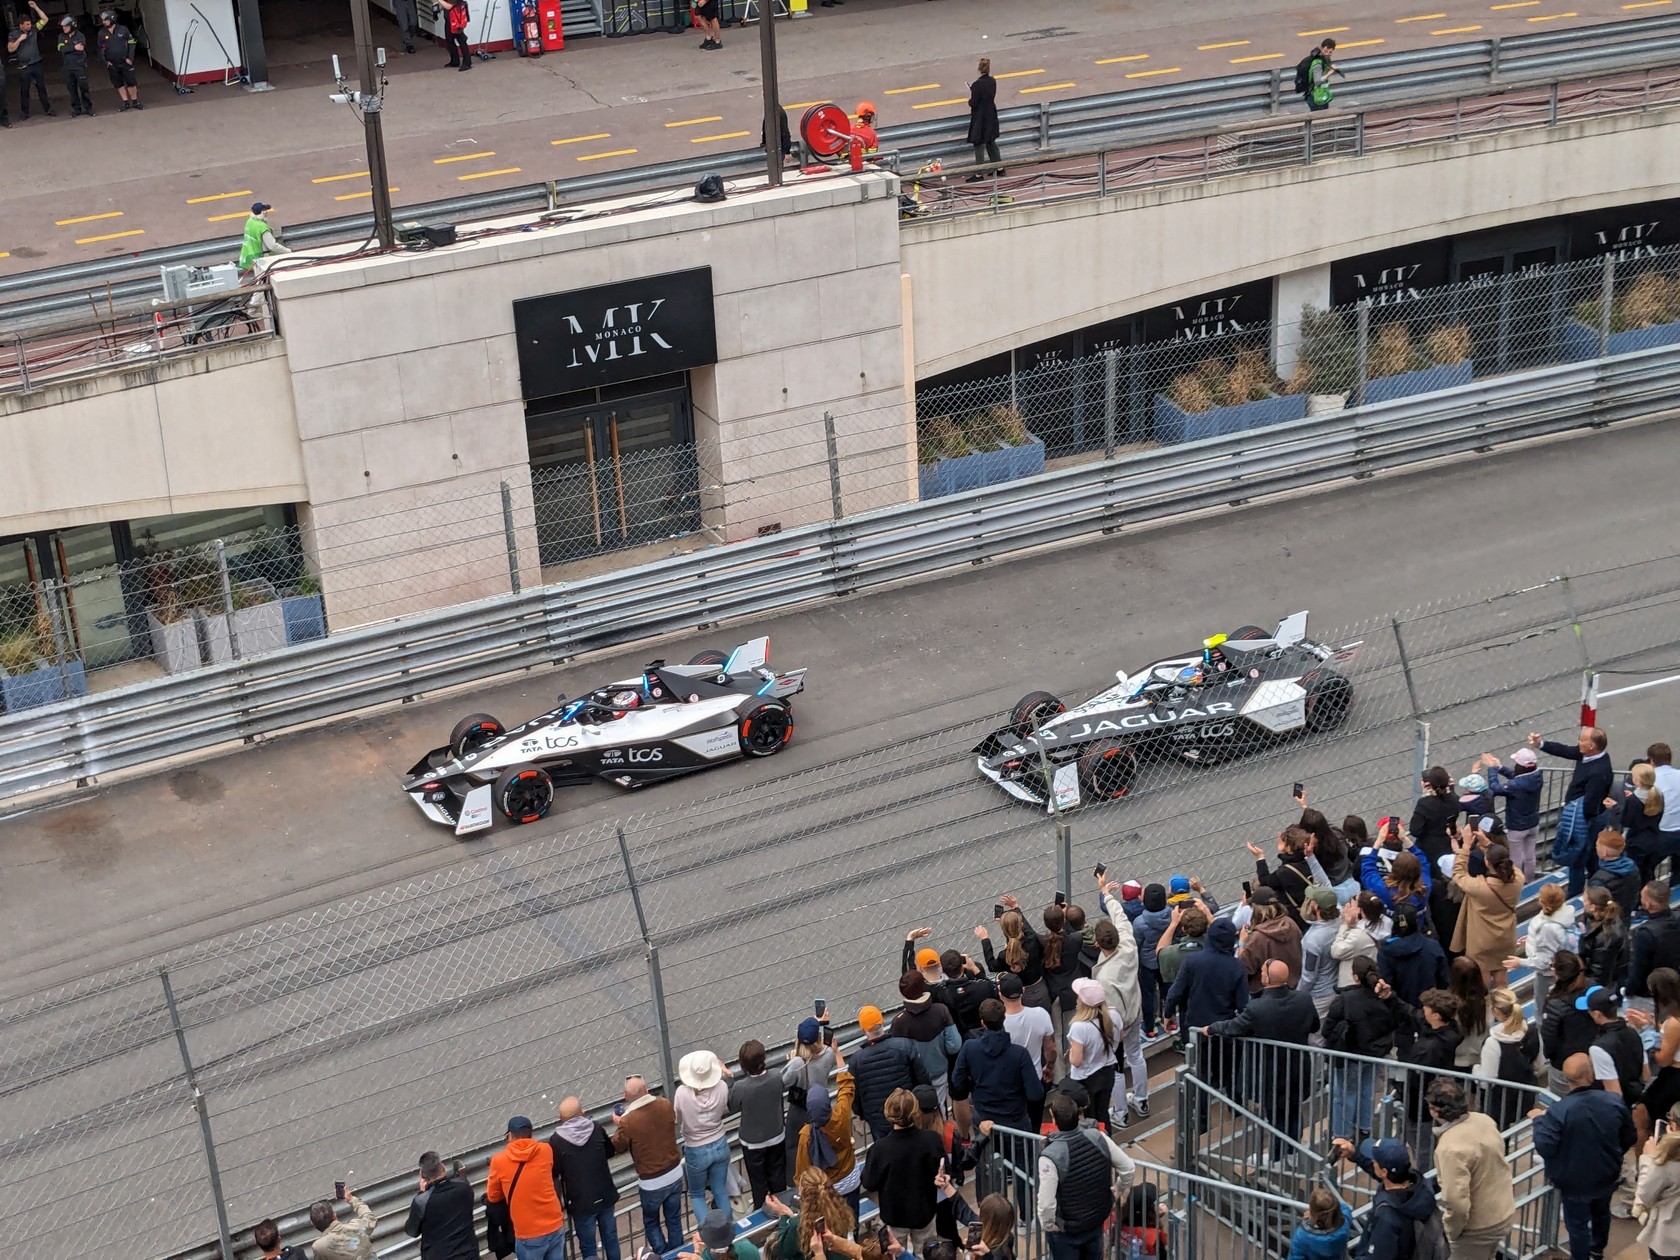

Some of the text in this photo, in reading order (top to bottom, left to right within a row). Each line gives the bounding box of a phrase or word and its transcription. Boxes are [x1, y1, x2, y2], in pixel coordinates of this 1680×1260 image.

[1192, 313, 1226, 325] MONACO
[562, 298, 673, 368] MK
[595, 324, 642, 341] MONACO
[1069, 700, 1237, 740] JAGUAR
[1173, 732, 1197, 741] TATA
[1200, 721, 1236, 739] tcs
[545, 735, 579, 749] tcs
[704, 741, 738, 755] JAGUAR
[520, 746, 543, 754] TATA
[628, 747, 663, 763] tcs
[600, 757, 625, 766] TATA
